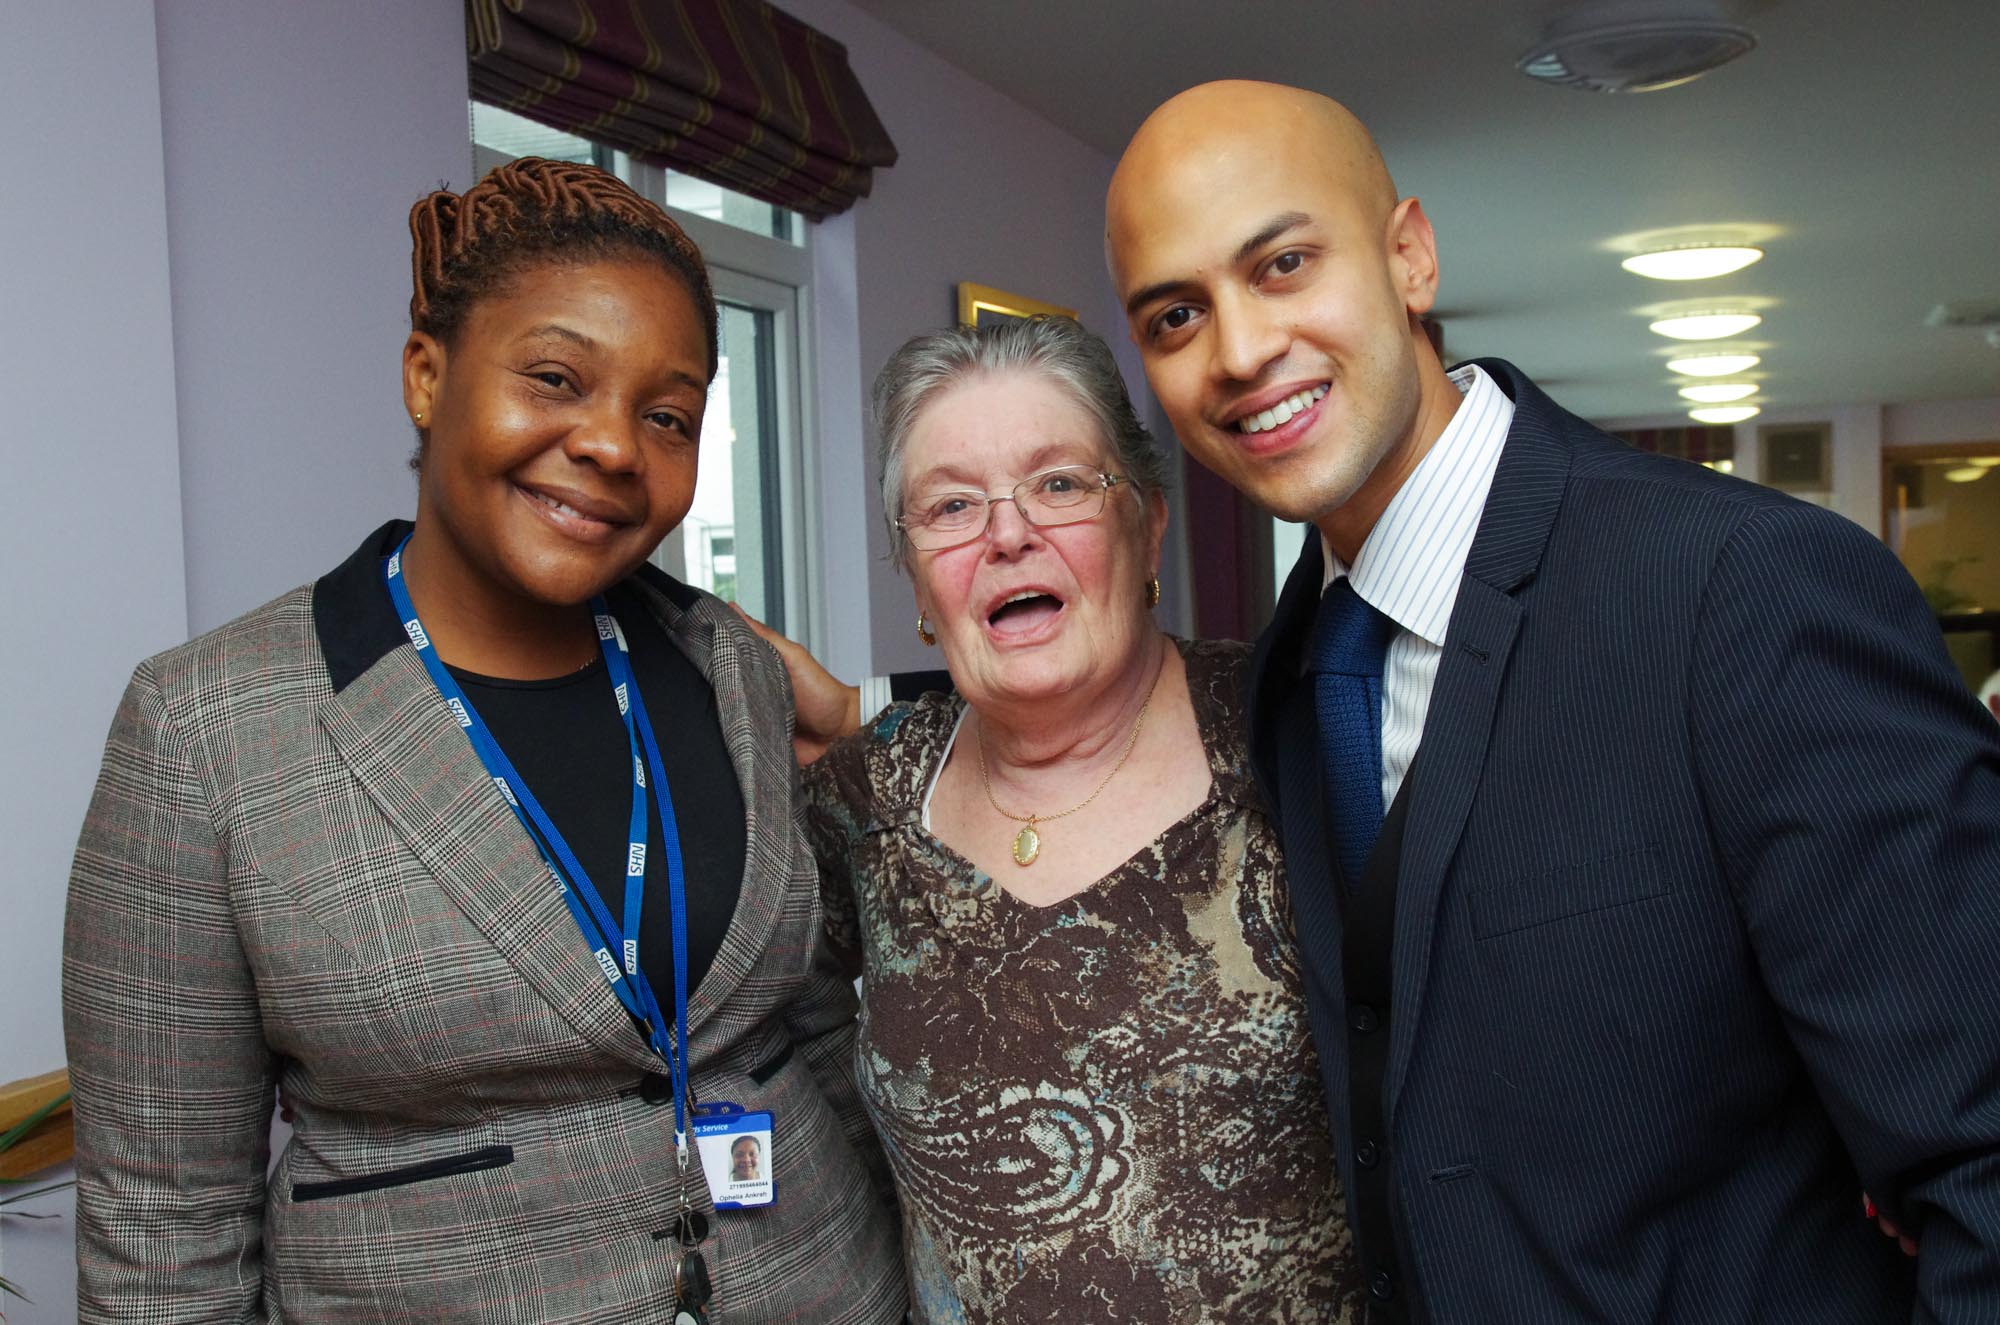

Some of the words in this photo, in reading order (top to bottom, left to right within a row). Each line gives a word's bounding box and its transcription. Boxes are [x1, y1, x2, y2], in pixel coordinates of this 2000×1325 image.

[407, 621, 427, 648] NHS
[596, 616, 614, 638] NHS
[617, 686, 627, 712] NHS
[451, 700, 470, 727] NHS
[636, 760, 645, 784] NHS
[498, 779, 515, 804] NHS
[630, 845, 644, 874] NHS
[600, 951, 619, 981] NHS
[626, 942, 635, 973] NHS
[702, 1124, 729, 1132] Service
[719, 1193, 743, 1201] Ophelia
